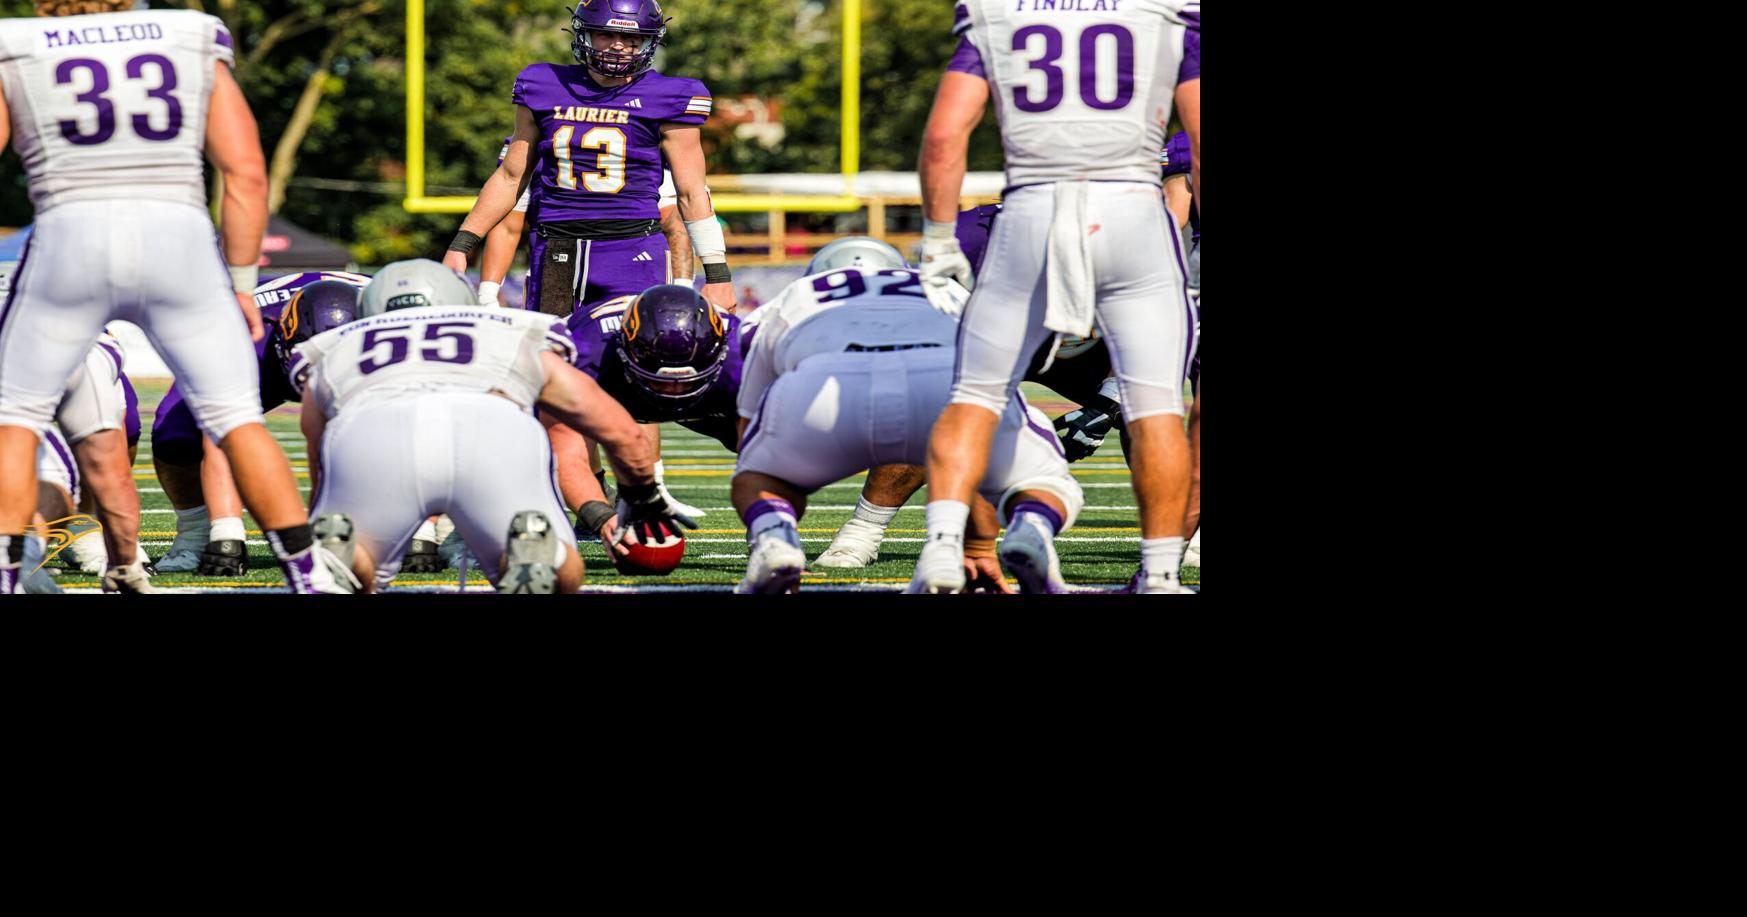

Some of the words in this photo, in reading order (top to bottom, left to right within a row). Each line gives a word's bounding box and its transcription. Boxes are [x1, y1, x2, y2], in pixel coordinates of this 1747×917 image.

[1016, 0, 1121, 11] FINDLAY
[44, 23, 163, 48] MACLEOD
[1012, 24, 1135, 113] 30
[55, 53, 183, 146] 33
[553, 106, 630, 125] LAURIER
[553, 125, 627, 194] 13
[812, 269, 927, 303] 92
[359, 322, 476, 375] 55
